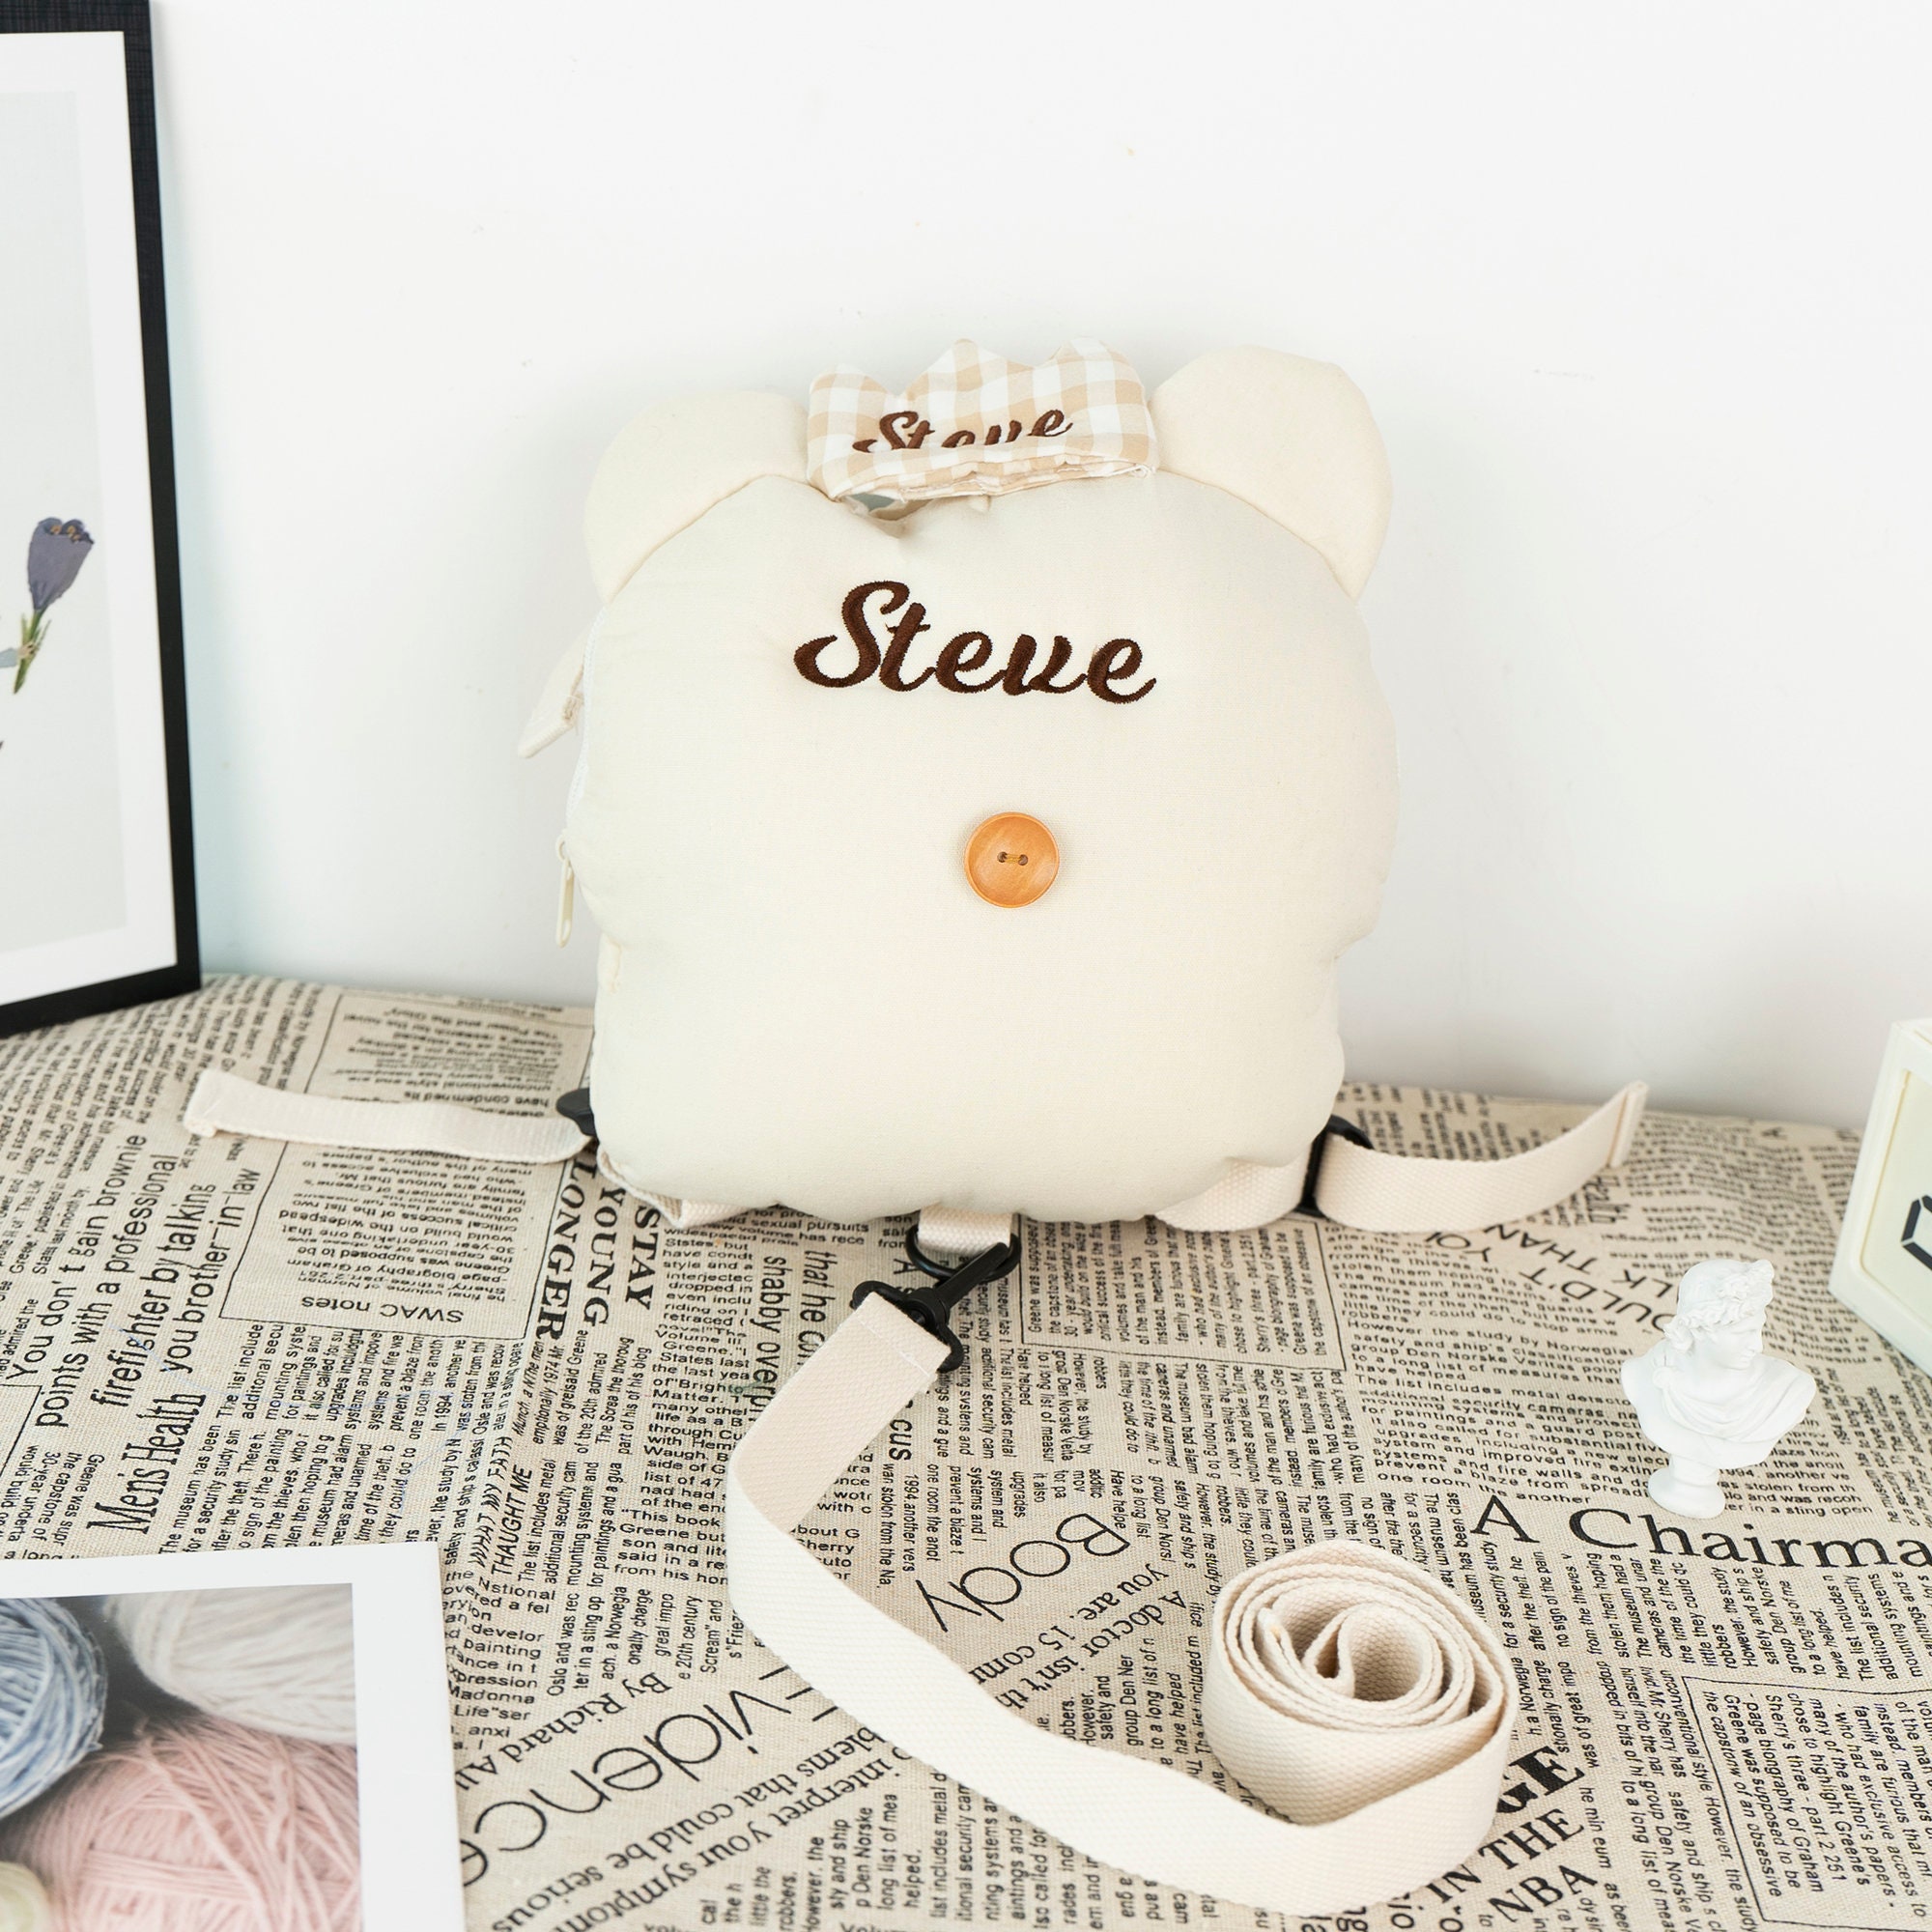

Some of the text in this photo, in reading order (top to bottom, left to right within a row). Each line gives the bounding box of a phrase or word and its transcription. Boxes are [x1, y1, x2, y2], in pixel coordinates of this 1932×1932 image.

[793, 580, 1157, 705] Steve
[5, 1335, 53, 1388] You
[67, 1215, 109, 1258] gain
[94, 1135, 148, 1207] brownie
[538, 1159, 598, 1341] LONGER
[582, 1186, 628, 1327] YOUNG
[624, 1204, 666, 1311] STAY
[802, 1249, 838, 1289] that
[1482, 1221, 1598, 1274] THAN
[34, 1154, 186, 1435] points with a professional
[89, 1183, 216, 1408] firefighter by talking
[301, 1294, 464, 1323] SWAC notes
[749, 1255, 793, 1334] shabby
[799, 1293, 837, 1323] he
[159, 1328, 199, 1378] you
[1347, 1319, 1422, 1335] However
[1432, 1327, 1459, 1337] the
[1466, 1330, 1513, 1346] study
[1447, 1350, 1508, 1366] Norske
[542, 1360, 561, 1385] 1974
[551, 1424, 569, 1446] was
[565, 1329, 589, 1366] Greene
[1354, 1362, 1466, 1381] have helped
[117, 1380, 208, 1480] Health
[157, 1533, 183, 1555] The
[171, 1479, 202, 1529] museum
[196, 1424, 222, 1453] been
[467, 1435, 514, 1569] WHAT MY FATH
[1374, 1457, 1570, 1490] prevent blaze from
[1377, 1472, 1592, 1505] one room the another
[490, 1463, 533, 1576] THAUGHT ME
[517, 1458, 557, 1582] The list includes metal
[620, 1522, 690, 1540] Greene
[1470, 1494, 1540, 1544] A
[1116, 1561, 1170, 1602] you
[1156, 1586, 1190, 1620] A
[674, 1595, 704, 1669] 20th century
[1037, 1623, 1074, 1649] 15
[1079, 1600, 1167, 1659] doctor
[1612, 1564, 1653, 1658] The museum had
[546, 1592, 581, 1697] Oslo and was rec
[654, 1625, 672, 1658] great
[620, 1671, 672, 1699] By
[1701, 1690, 1724, 1714] the
[497, 1691, 627, 1764] Richard
[1741, 1701, 1768, 1736] page
[1764, 1694, 1797, 1750] Sherry's
[733, 1773, 798, 1808] that
[767, 1747, 900, 1828] interpret
[1722, 1693, 1802, 1889] Greene was supposed to be
[1732, 1781, 1753, 1797] of
[1739, 1799, 1757, 1818] an
[1786, 1692, 1820, 1734] chose
[1808, 1753, 1846, 1815] highlight
[1833, 1820, 1872, 1886] Greene's
[1852, 1705, 1927, 1856] family are furious that
[647, 1803, 734, 1854] could
[1785, 1817, 1807, 1833] of
[1833, 1711, 1927, 1918] who had exclusive access to
[606, 1842, 656, 1869] be
[696, 1820, 773, 1868] your
[1424, 1807, 1585, 1904] IN THE
[1746, 1823, 1783, 1897] obsessive
[1786, 1835, 1825, 1892] Graham
[492, 1865, 604, 1932] serious
[1487, 1864, 1599, 1923] NBA
